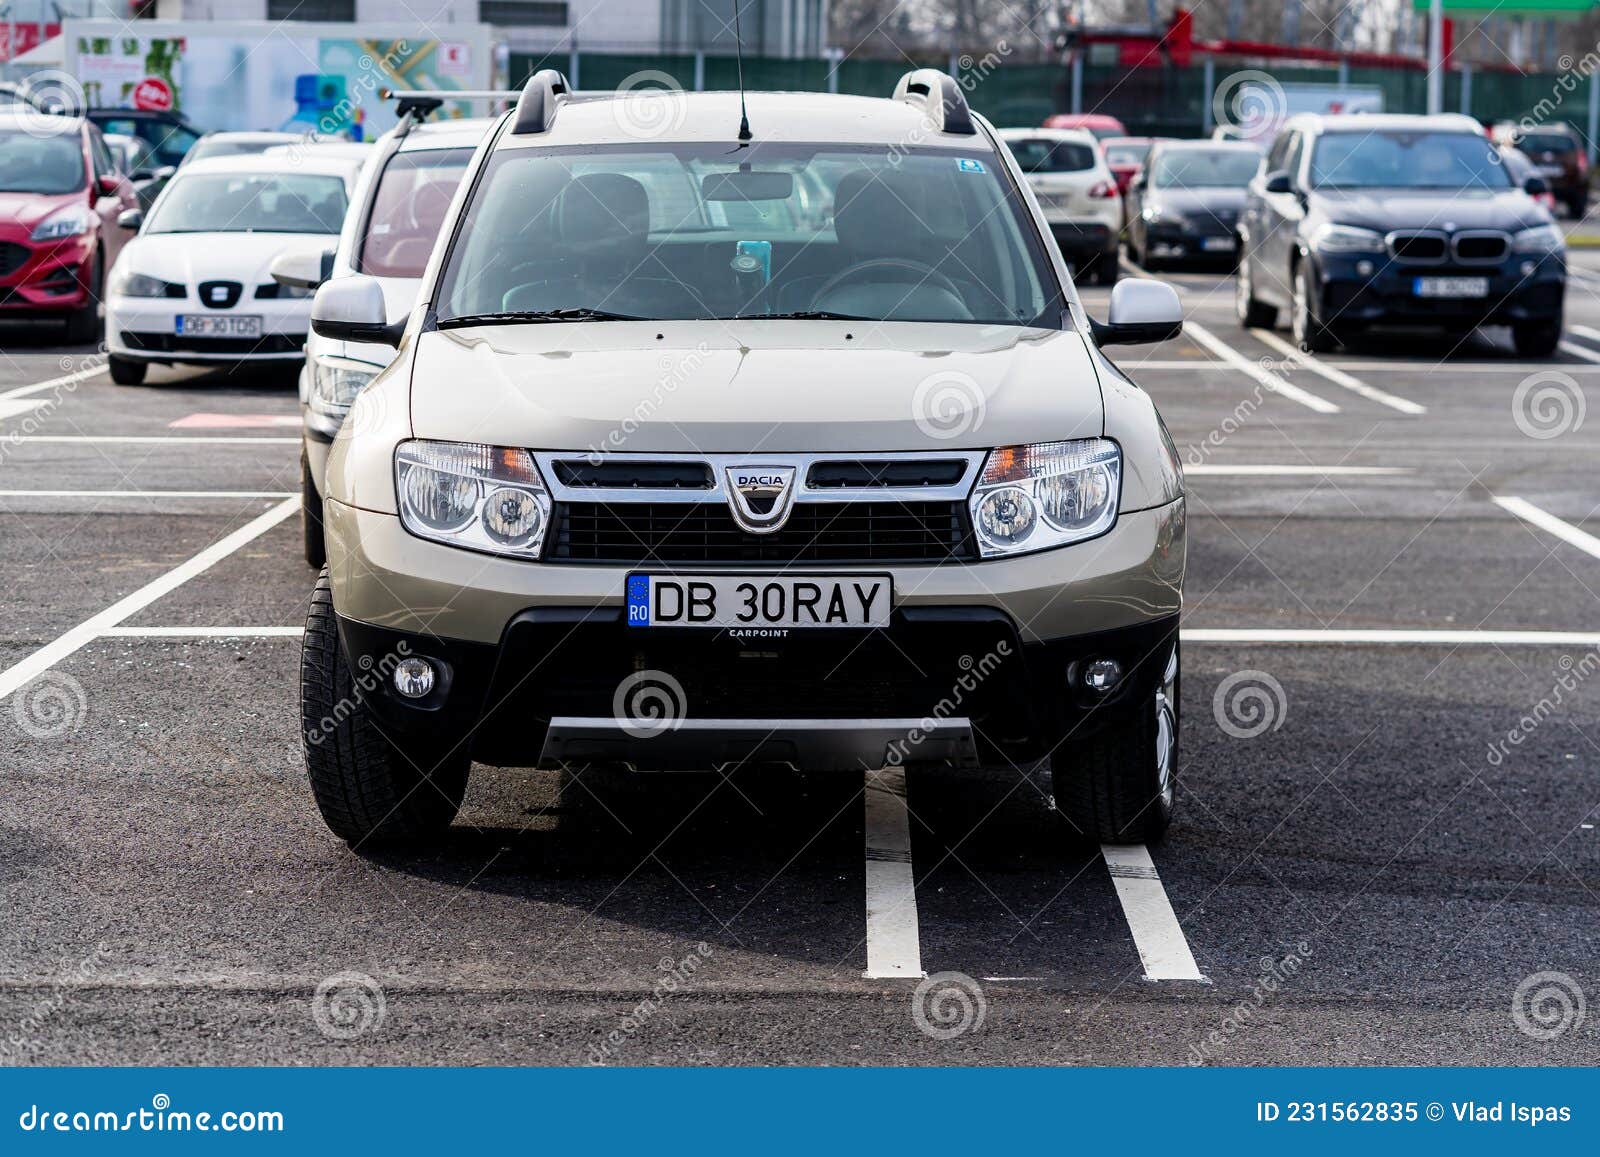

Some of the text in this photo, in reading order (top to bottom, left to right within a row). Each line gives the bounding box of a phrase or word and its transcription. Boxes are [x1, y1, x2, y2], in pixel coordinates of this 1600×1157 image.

[738, 476, 784, 485] DACIA
[630, 582, 881, 623] RO DB 30RAY
[729, 629, 789, 638] CARPOINT
